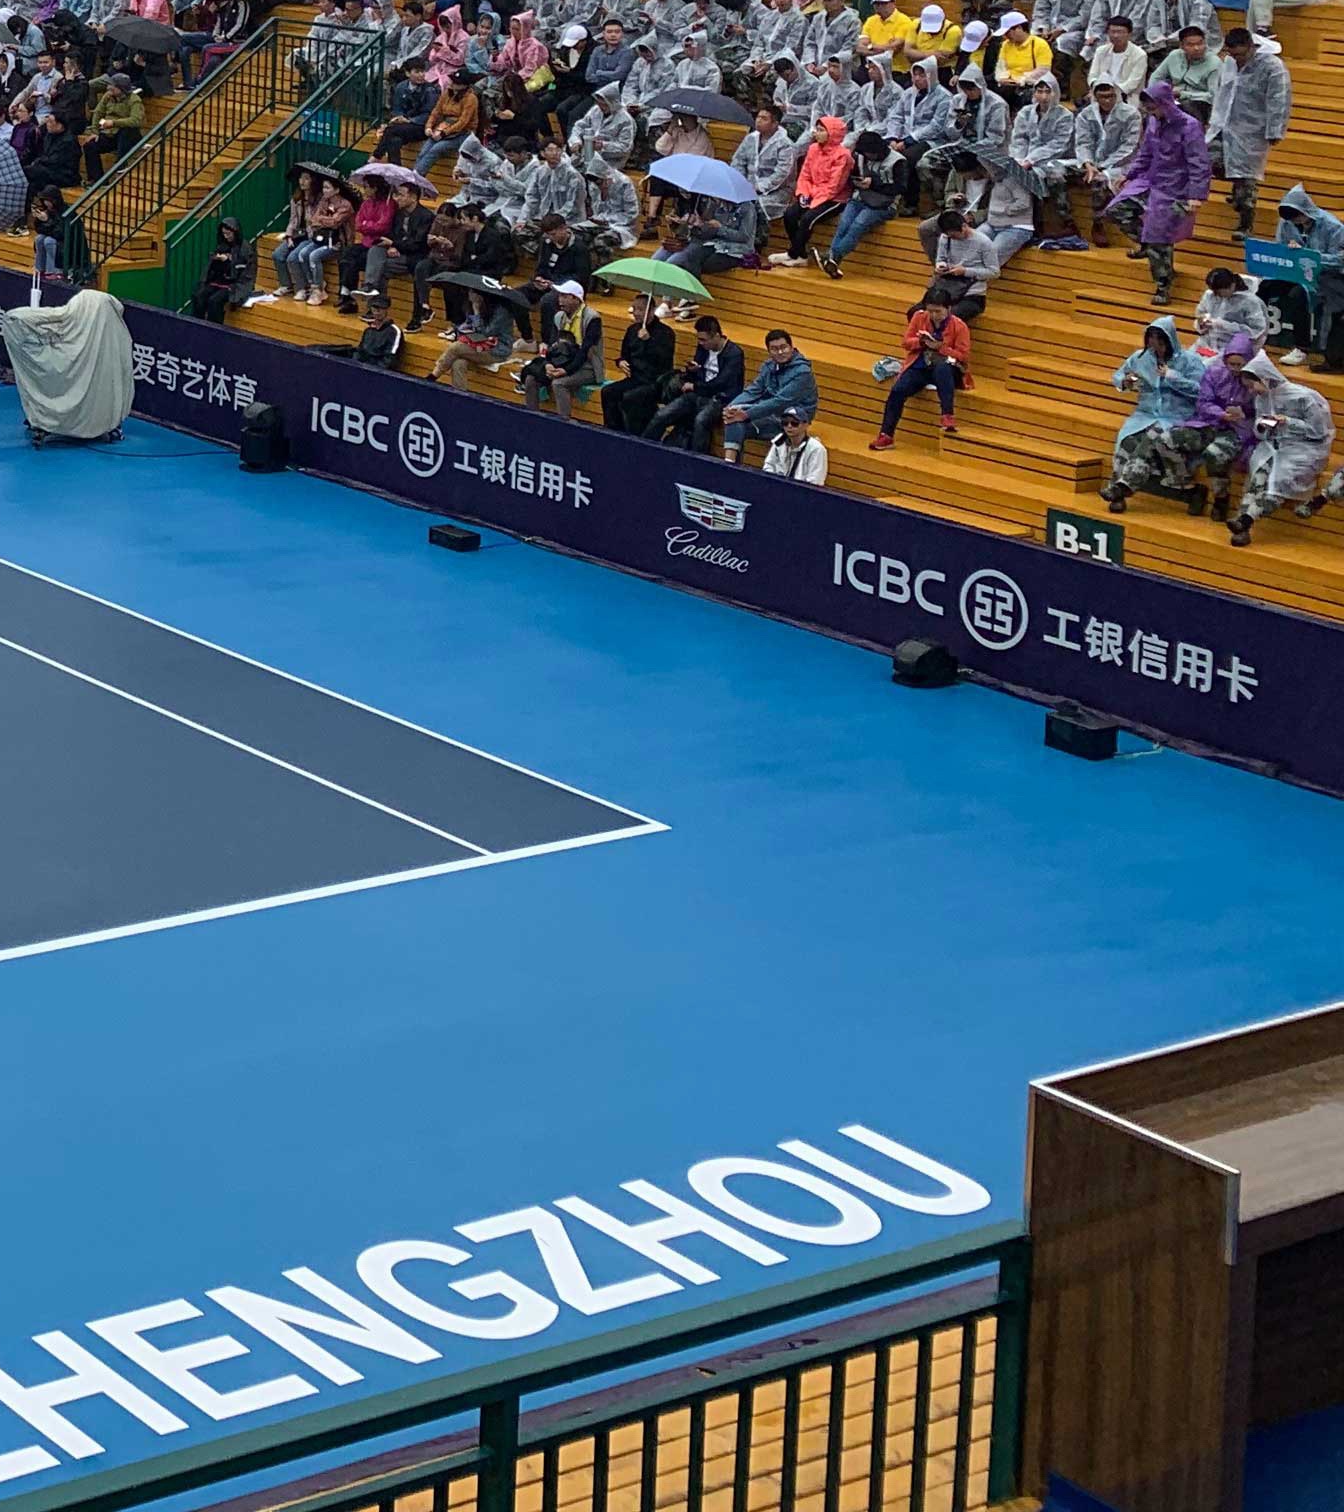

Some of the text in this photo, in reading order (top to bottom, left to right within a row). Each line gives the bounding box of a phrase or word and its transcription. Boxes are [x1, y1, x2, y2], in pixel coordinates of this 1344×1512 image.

[132, 342, 258, 410] 爱奇艺体育
[311, 397, 594, 509] ICBC 工银信用卡
[664, 526, 750, 573] Cadillac
[1056, 521, 1112, 563] B-1
[833, 542, 1259, 703] ICBC 工银信用卡
